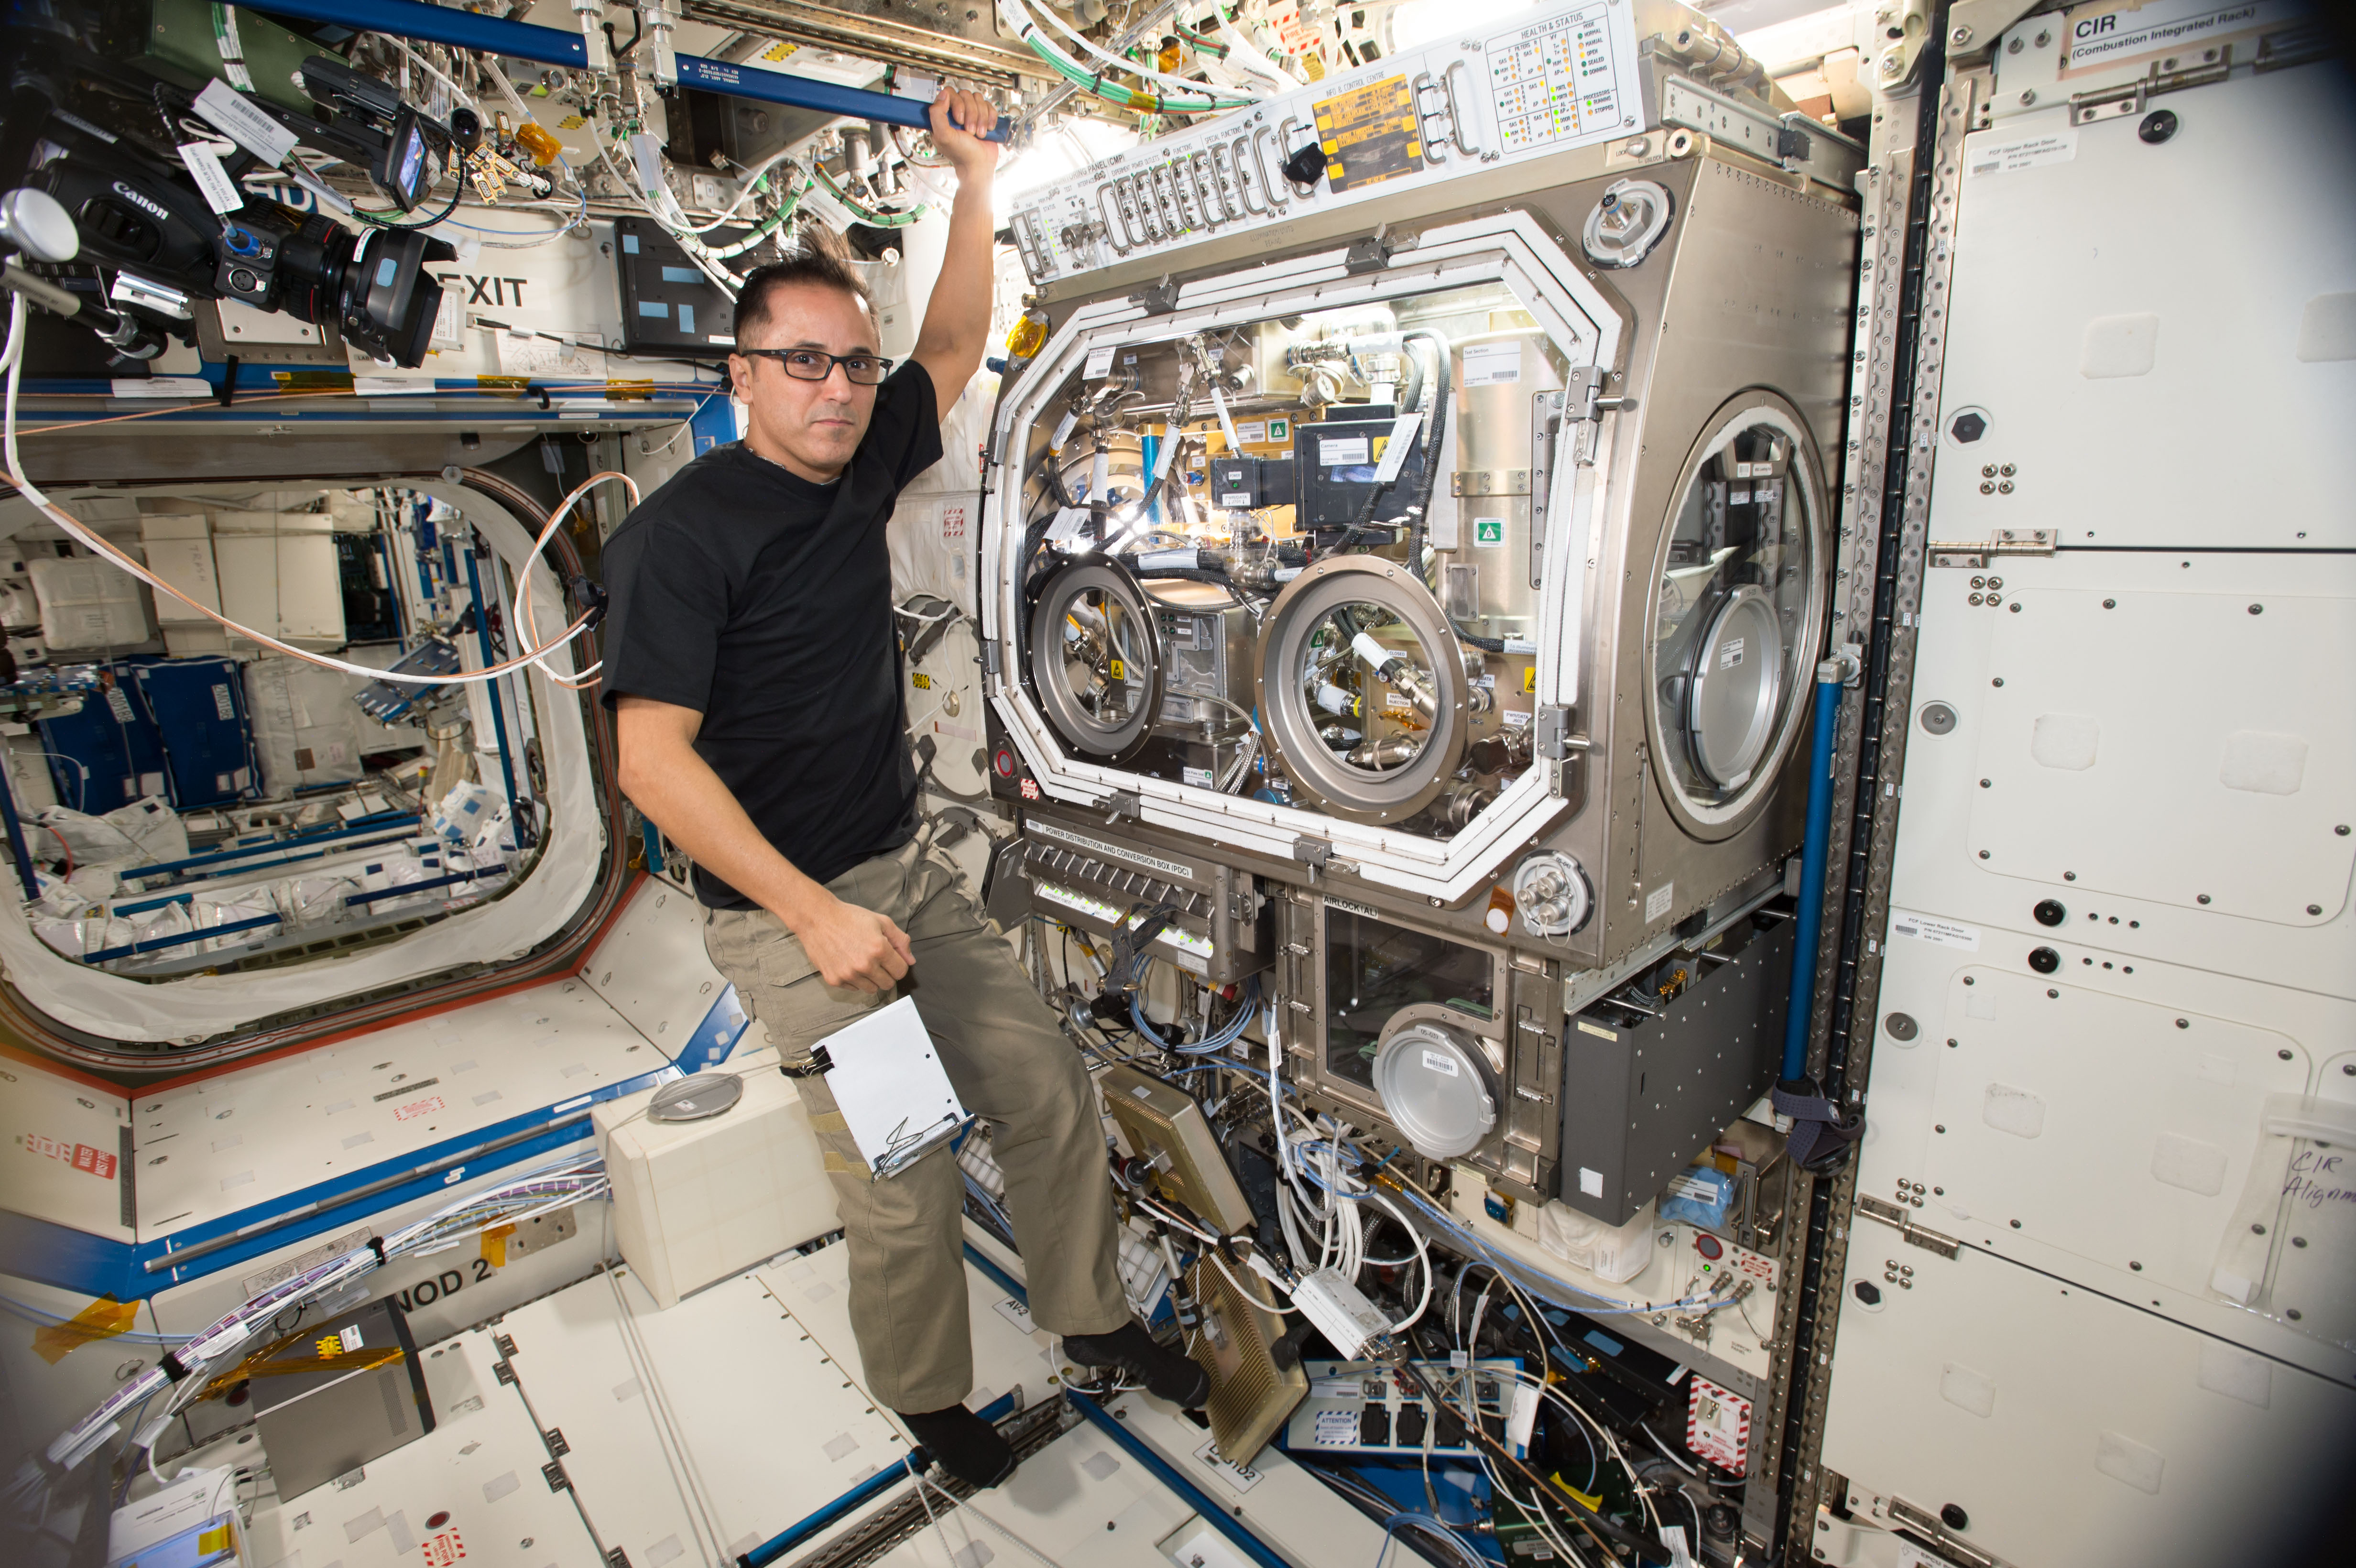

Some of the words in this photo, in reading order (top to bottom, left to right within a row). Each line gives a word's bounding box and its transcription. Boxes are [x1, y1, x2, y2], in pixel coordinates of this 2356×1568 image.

[1520, 23, 1547, 39] HEALTH
[1547, 22, 1554, 30] &
[1554, 11, 1584, 28] STATUS
[1584, 29, 1602, 37] NORMAL
[2071, 33, 2150, 60] (Combustion
[2149, 17, 2214, 43] Integrated
[2216, 6, 2258, 25] Rack)
[2075, 14, 2116, 40] CIR
[1286, 30, 1300, 39] FIRE
[1585, 38, 1603, 46] MANUAL
[1514, 43, 1531, 52] FILTERS
[1587, 57, 1604, 65] SEALED
[1325, 87, 1337, 97] INFO
[1342, 78, 1365, 91] CONTROL
[1365, 70, 1385, 83] CENTRE
[1582, 89, 1611, 100] PROCESSORS
[1593, 103, 1614, 113] STOPPED
[1204, 133, 1219, 143] SPECIAL
[1220, 126, 1242, 138] FUNCTIONS
[1172, 143, 1193, 154] FUNCTIONS
[2002, 145, 2022, 154] Upper
[2040, 138, 2058, 146] Door
[1111, 165, 1131, 177] EXPERIMENT
[1131, 160, 1144, 169] POWER
[1143, 154, 1160, 165] OUTLETS
[1644, 155, 1662, 163] UNLOCK
[1050, 166, 1088, 186] MONITORING
[1087, 159, 1108, 173] PANEL
[1106, 152, 1126, 167] (CMP)
[1063, 185, 1073, 193] TEST
[110, 178, 170, 222] Canon
[1042, 204, 1056, 212] STATUS
[1248, 228, 1280, 242] ILLUMINATION
[1279, 225, 1294, 235] UNITS
[1264, 237, 1282, 248] BEHIND
[435, 272, 527, 308] EXIT
[1044, 827, 1065, 838] POWER
[1064, 833, 1103, 850] DISTRIBUTION
[1103, 844, 1117, 854] AND
[1115, 849, 1156, 867] CONVERSION
[1156, 860, 1171, 871] BOX
[1170, 864, 1190, 877] (PDC)
[1323, 895, 1362, 912] AIRLOCK
[1361, 904, 1378, 916] (AL)
[77, 1146, 95, 1168] WATER
[2291, 1147, 2343, 1180] CIR
[393, 1267, 468, 1315] NOD
[468, 1256, 493, 1284] 2
[1004, 1297, 1029, 1318] AV-2
[1730, 1345, 1746, 1355] PANEL
[1731, 1341, 1753, 1353] SUPPORT
[1694, 1441, 1713, 1454] RACK
[1712, 1451, 1735, 1465] POWER
[1208, 1441, 1256, 1482] L1D2
[436, 1538, 446, 1549] FIRE
[440, 1549, 450, 1562] PORT
[1919, 1552, 1942, 1566] EPCU
